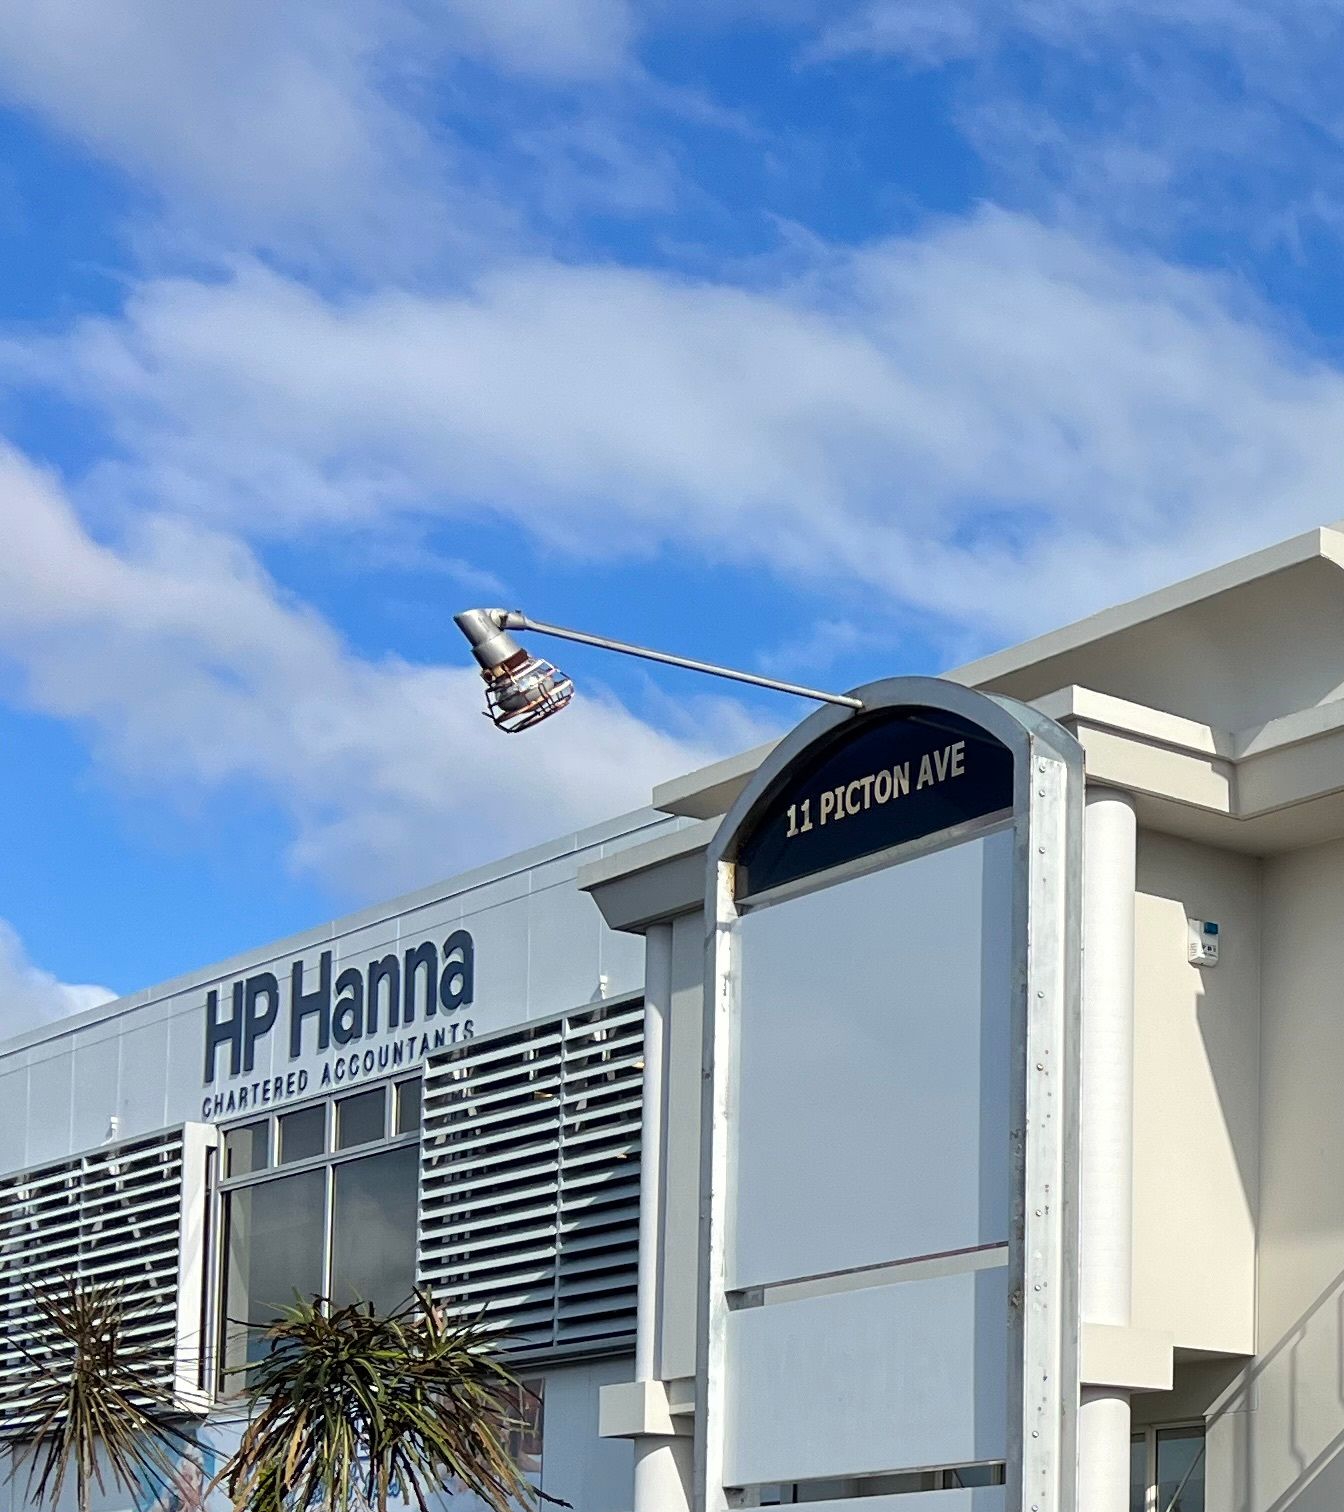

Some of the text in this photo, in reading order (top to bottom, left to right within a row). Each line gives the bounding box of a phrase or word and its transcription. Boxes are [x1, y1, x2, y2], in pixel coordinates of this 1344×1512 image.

[786, 740, 965, 838] 11 PICTON AVE
[203, 929, 475, 1084] HP Hanna
[202, 1019, 475, 1119] CHARTERED ACCOUNTANTS
